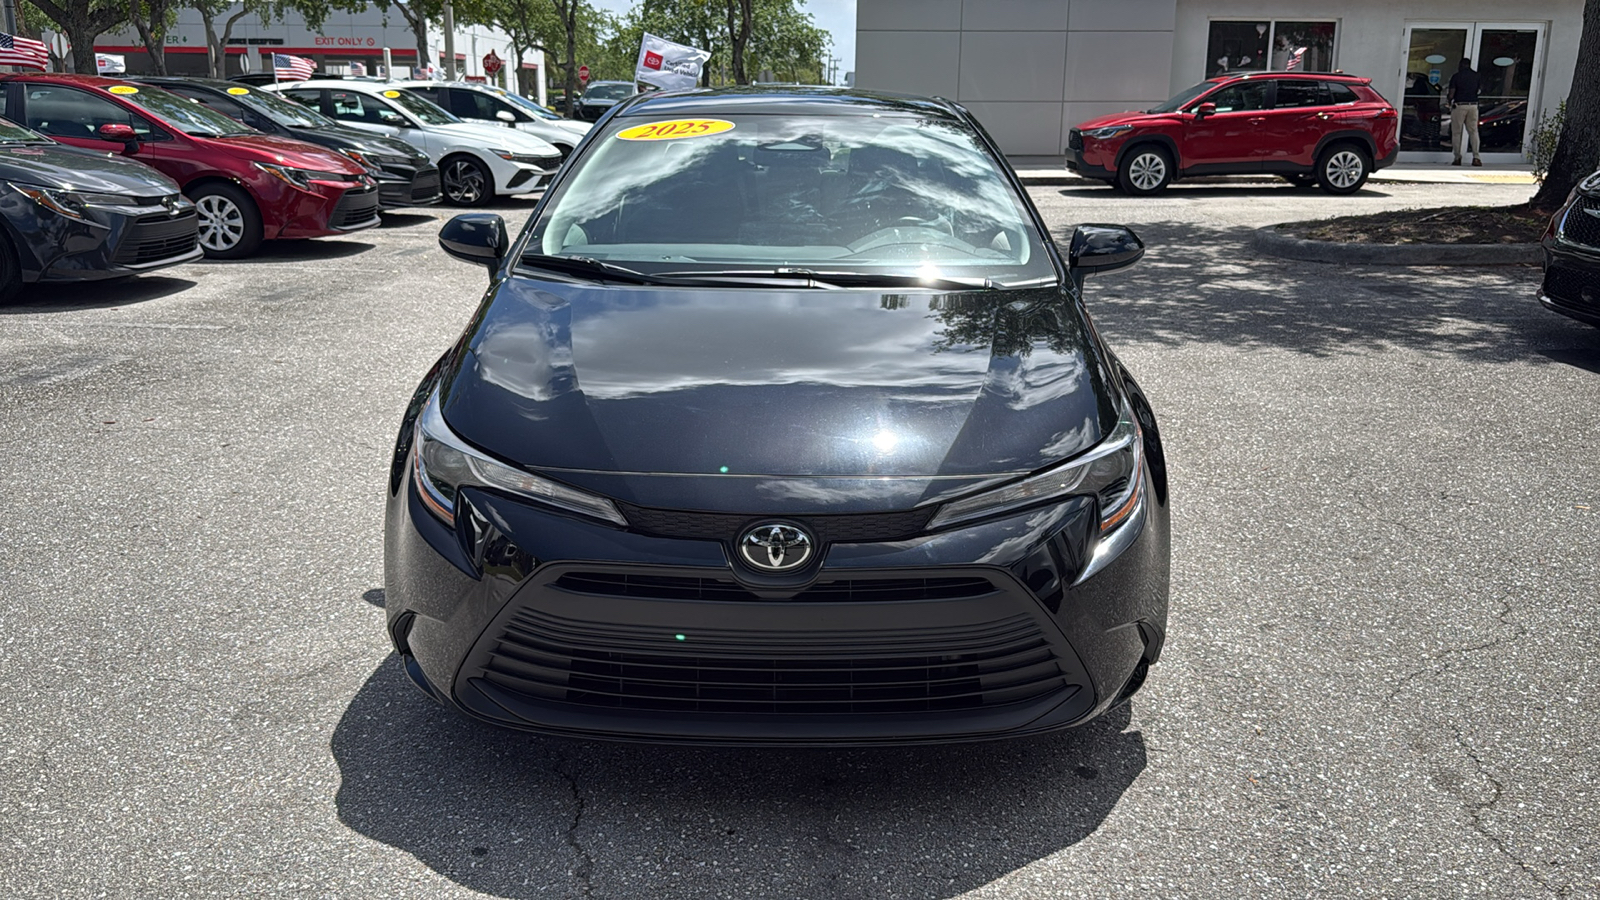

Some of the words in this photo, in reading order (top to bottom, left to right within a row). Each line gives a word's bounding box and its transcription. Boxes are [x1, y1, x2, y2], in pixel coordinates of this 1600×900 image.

[315, 37, 335, 46] EXIT
[337, 37, 363, 46] ONLY
[635, 121, 715, 139] 2025
